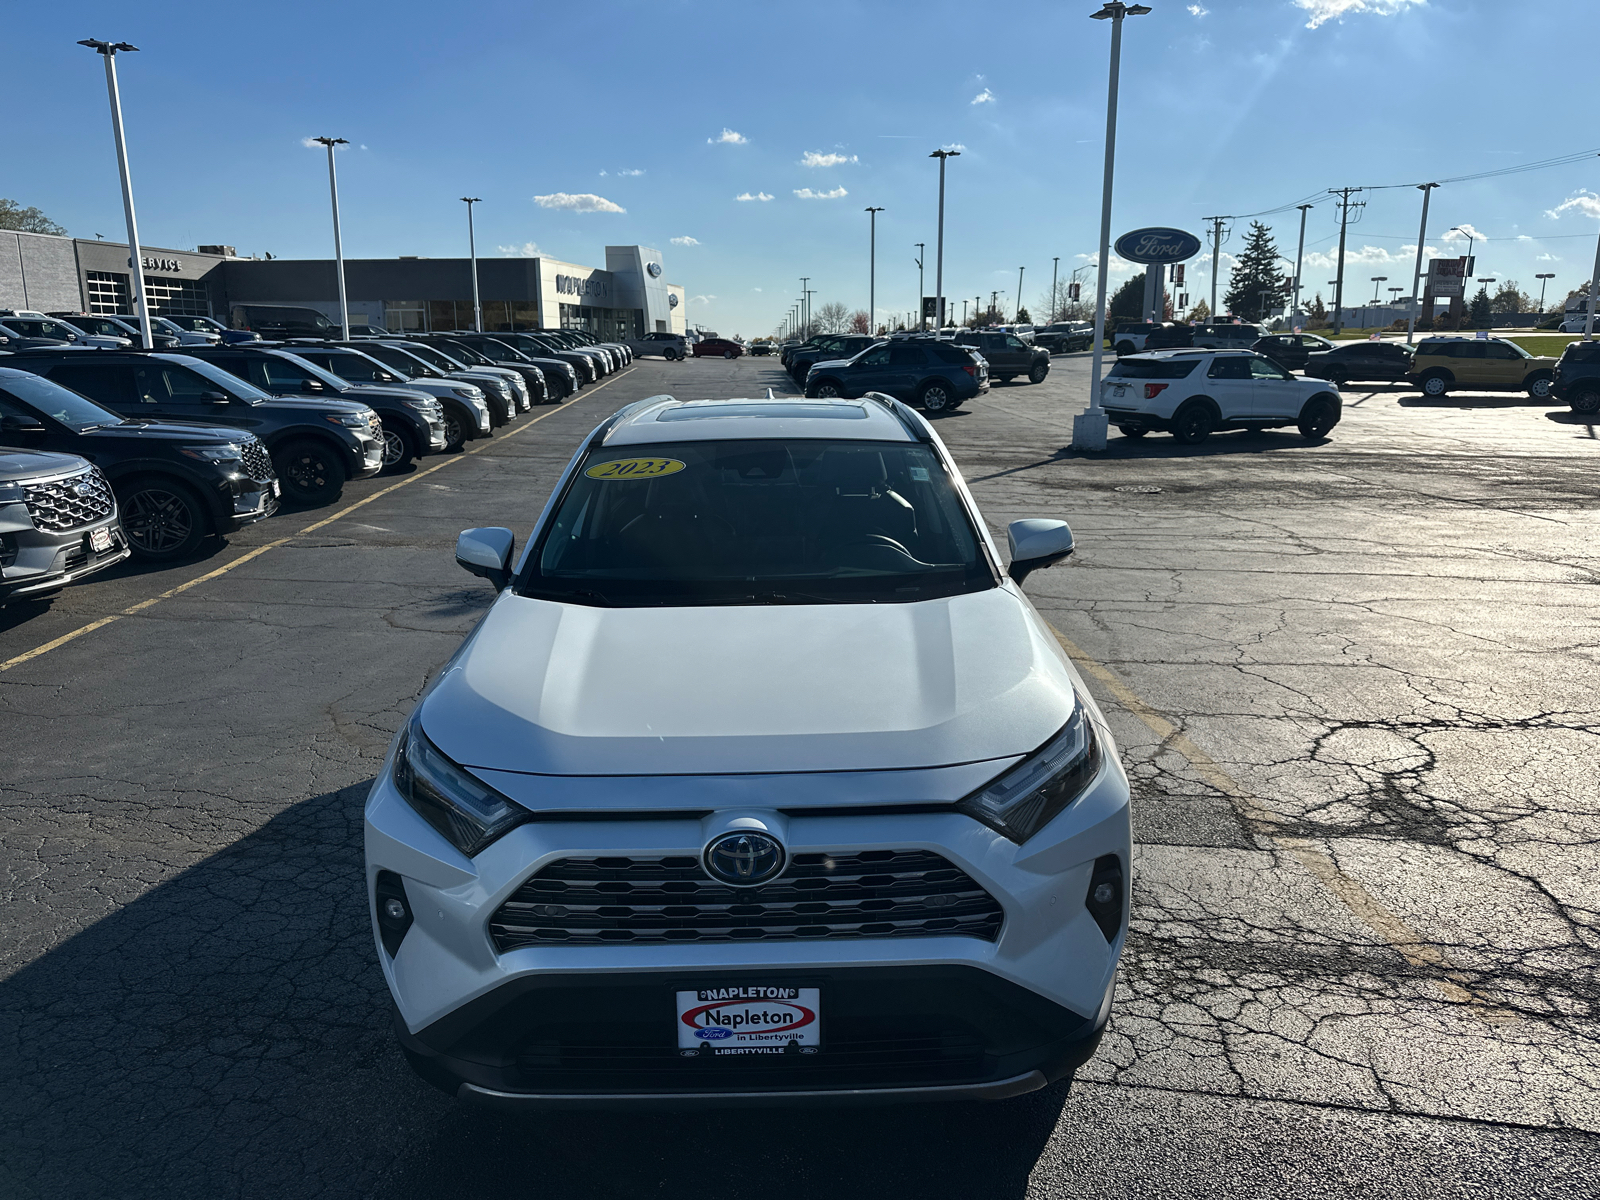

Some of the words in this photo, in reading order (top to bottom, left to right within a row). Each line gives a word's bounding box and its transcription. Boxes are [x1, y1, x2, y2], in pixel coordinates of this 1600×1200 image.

[1134, 234, 1184, 256] Ford
[131, 256, 183, 271] ERVICE
[556, 274, 608, 299] NAPLETON
[599, 461, 671, 476] 2023
[706, 987, 790, 1000] NAPLETON
[704, 1009, 794, 1029] Napleton
[702, 1029, 727, 1039] Ford
[749, 1033, 805, 1041] Libertyville
[715, 1047, 785, 1055] LIBERTYVILLE
